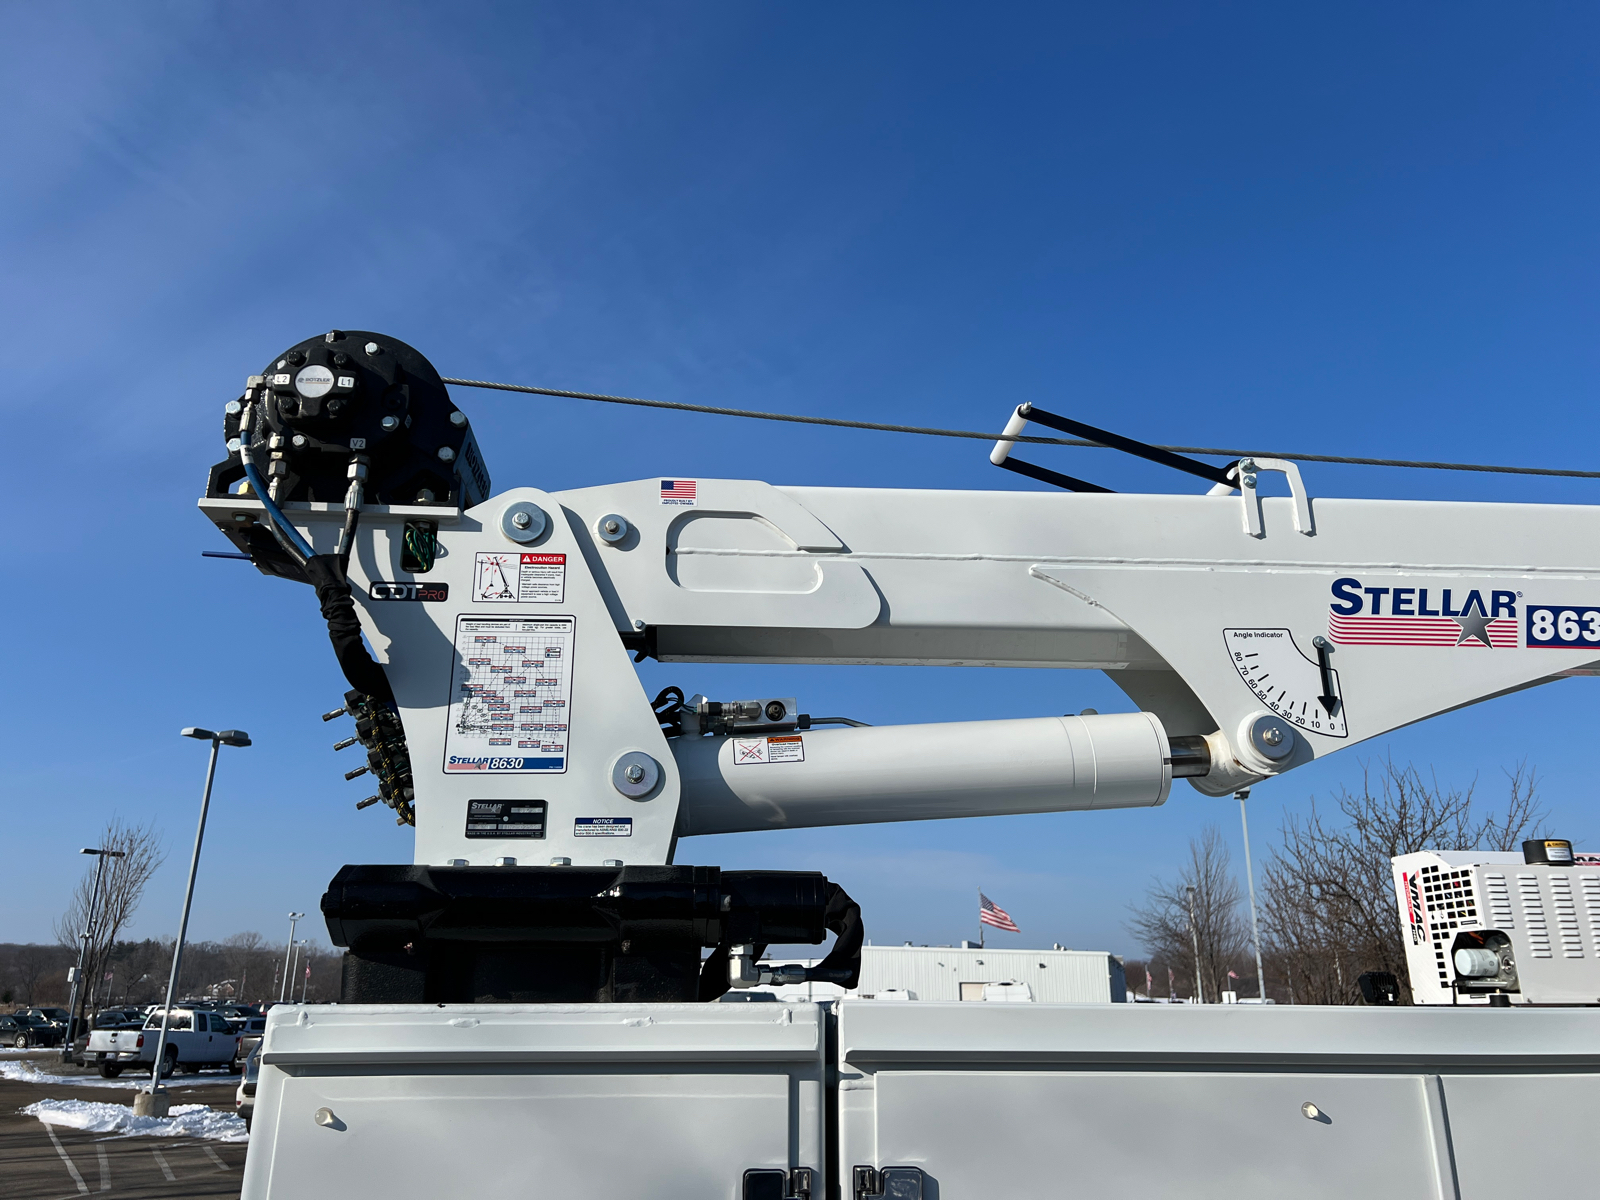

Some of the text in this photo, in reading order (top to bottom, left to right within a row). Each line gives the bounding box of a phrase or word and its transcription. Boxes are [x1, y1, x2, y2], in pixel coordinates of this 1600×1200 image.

[276, 375, 288, 384] L2
[352, 440, 364, 448] V2
[1234, 652, 1243, 662] 80
[1240, 665, 1249, 676] 70
[1248, 679, 1258, 689] 60
[1257, 690, 1267, 700] 50
[1269, 702, 1279, 711] 40
[1282, 710, 1292, 719] 30
[1295, 716, 1305, 725] 20
[449, 755, 524, 769] STELLAR 8630
[1408, 873, 1426, 942] VMAC
